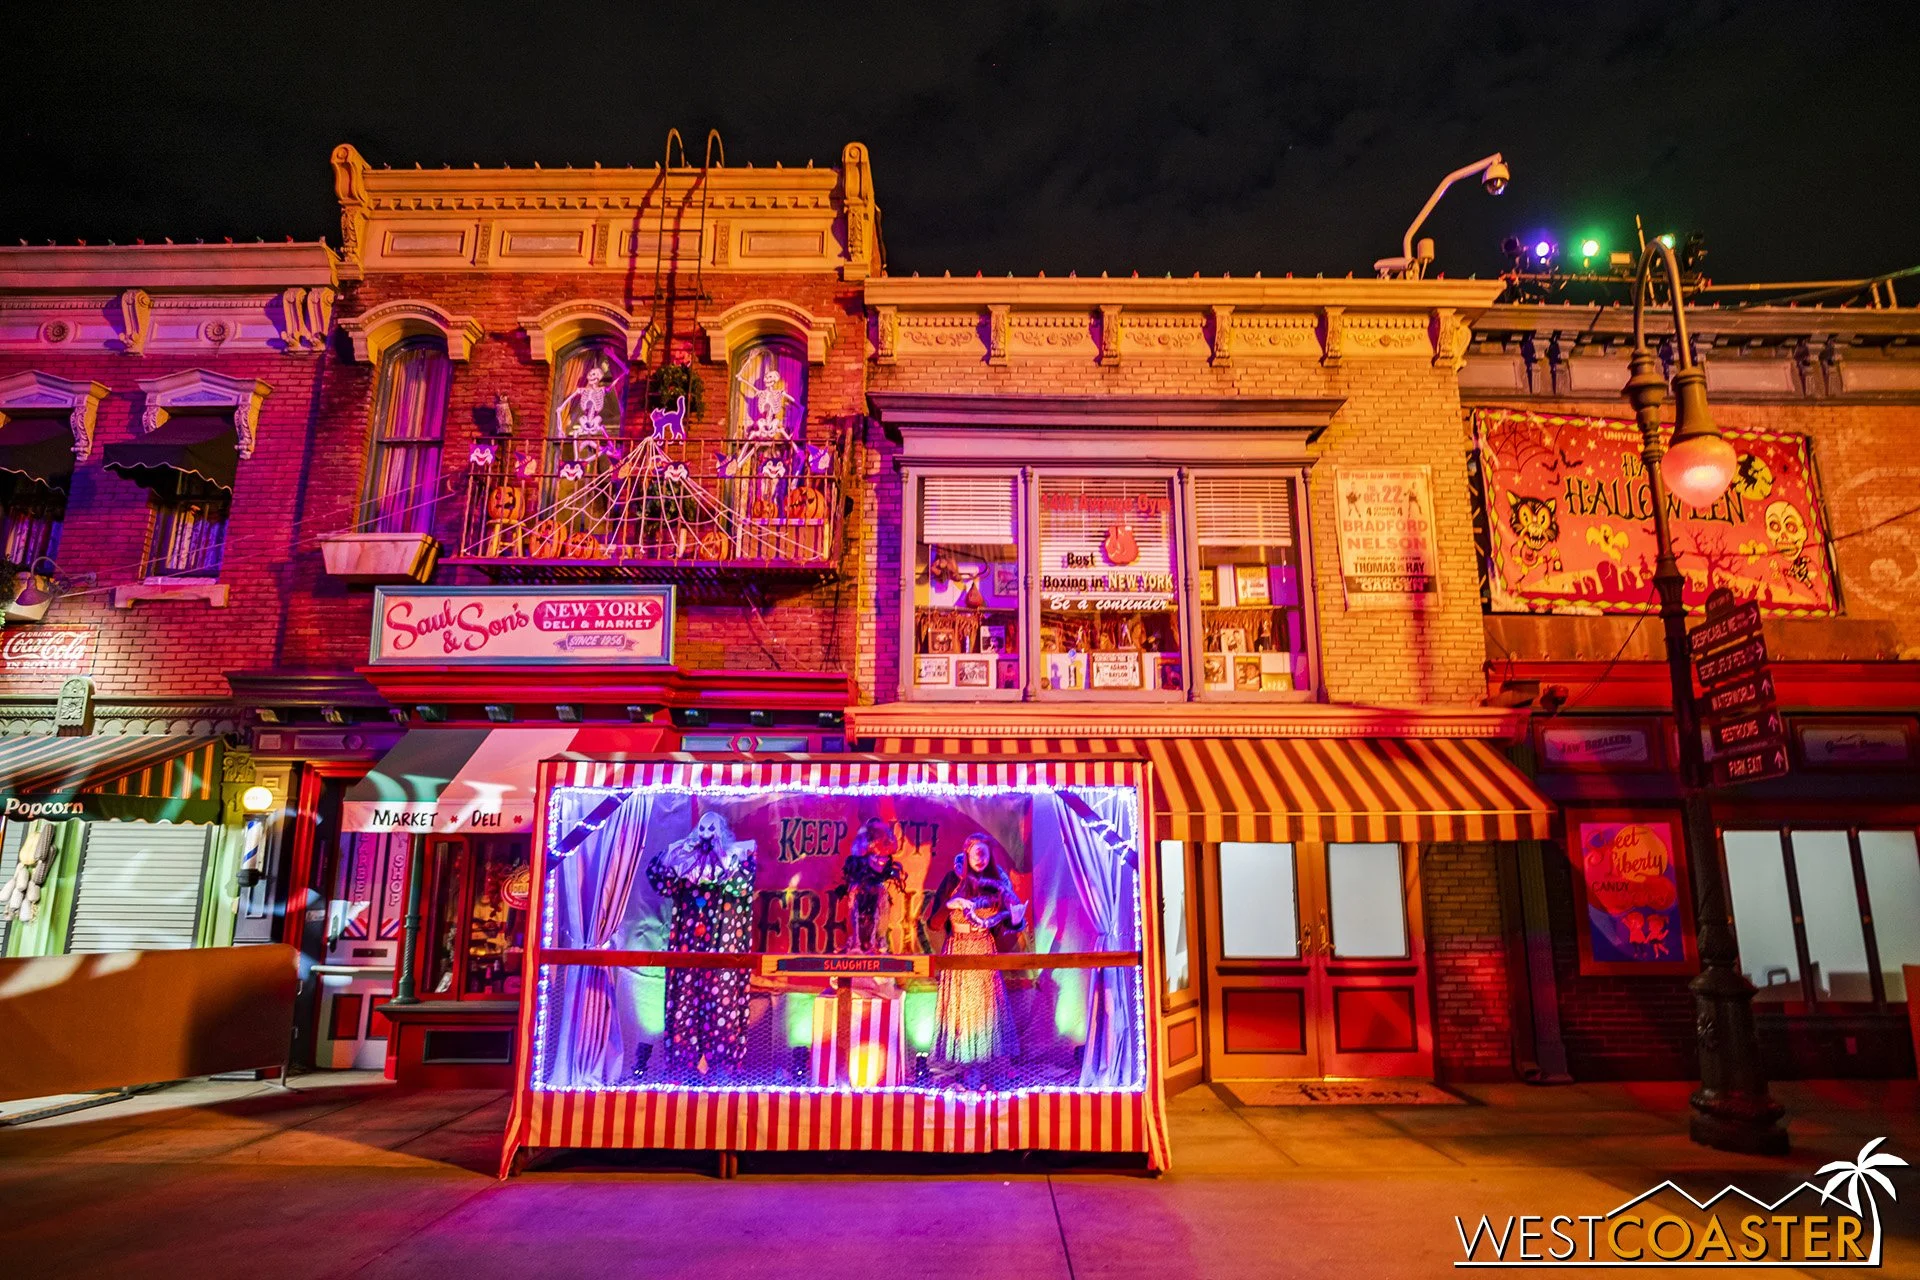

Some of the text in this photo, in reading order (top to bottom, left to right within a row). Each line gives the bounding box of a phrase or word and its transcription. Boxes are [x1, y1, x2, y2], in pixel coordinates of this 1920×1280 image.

[1382, 485, 1402, 503] 22
[1137, 493, 1171, 517] Gym
[1343, 519, 1428, 532] BRADFORD
[1347, 537, 1427, 550] NELSON
[1066, 552, 1095, 567] Best
[1353, 562, 1396, 573] THOMAS
[1043, 575, 1087, 591] Boxing
[1091, 576, 1103, 588] in
[1361, 581, 1425, 592] GARDEN
[544, 601, 652, 618] NEW YORK
[1077, 599, 1089, 610] a
[386, 598, 456, 650] Saul
[443, 602, 530, 654] & Son's
[543, 619, 652, 629] DELI & MARKET
[568, 635, 624, 646] SINCE 1956
[6, 662, 20, 670] IN
[1721, 719, 1759, 743] RESTROOMS
[5, 797, 84, 819] Popcorn
[778, 817, 848, 863] KEEP
[1605, 850, 1663, 877] Liberty
[389, 854, 405, 907] SHOP
[1591, 881, 1630, 892] CANDY
[824, 959, 880, 971] SLAUGHTER
